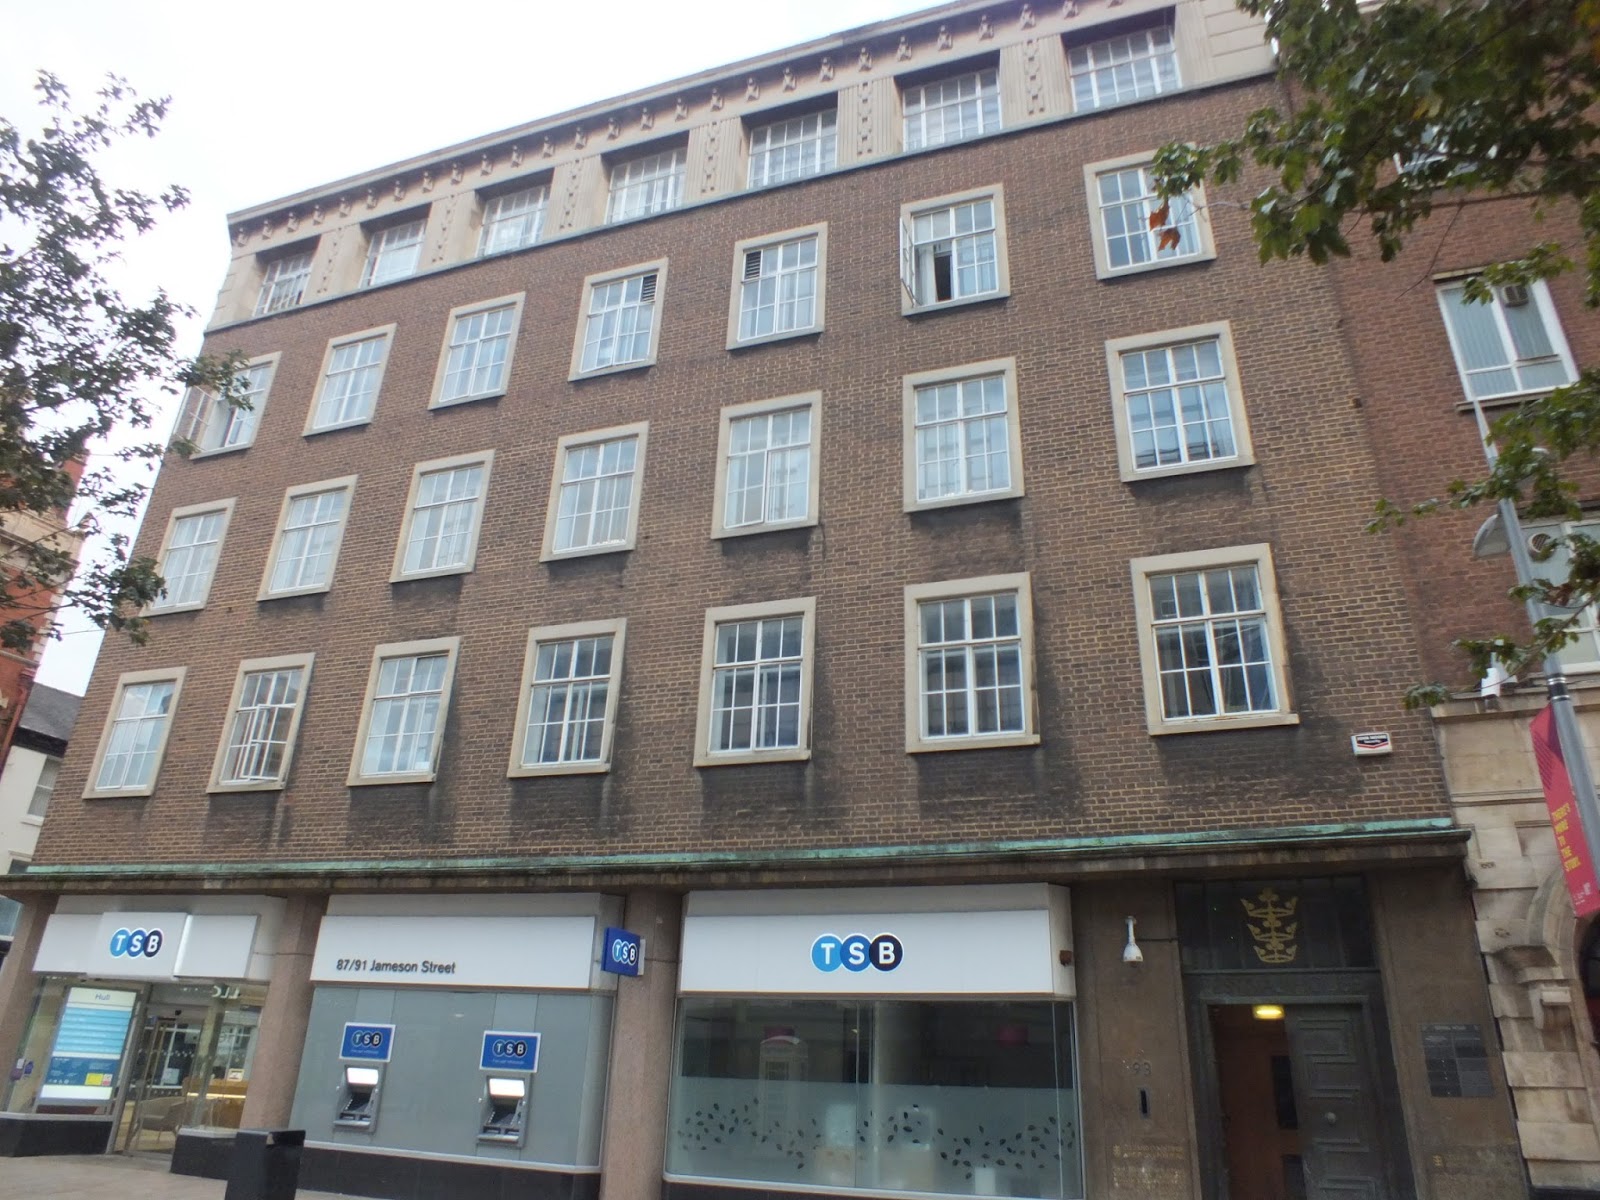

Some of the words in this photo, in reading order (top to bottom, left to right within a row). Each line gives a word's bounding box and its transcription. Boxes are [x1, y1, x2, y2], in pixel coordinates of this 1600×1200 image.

[113, 932, 161, 954] TSB
[614, 942, 636, 962] TSB
[816, 938, 899, 968] TSB
[336, 959, 367, 971] 87/91
[370, 959, 418, 973] Jameson
[421, 960, 456, 974] Street
[354, 1032, 381, 1046] TSB
[494, 1041, 525, 1055] TSB
